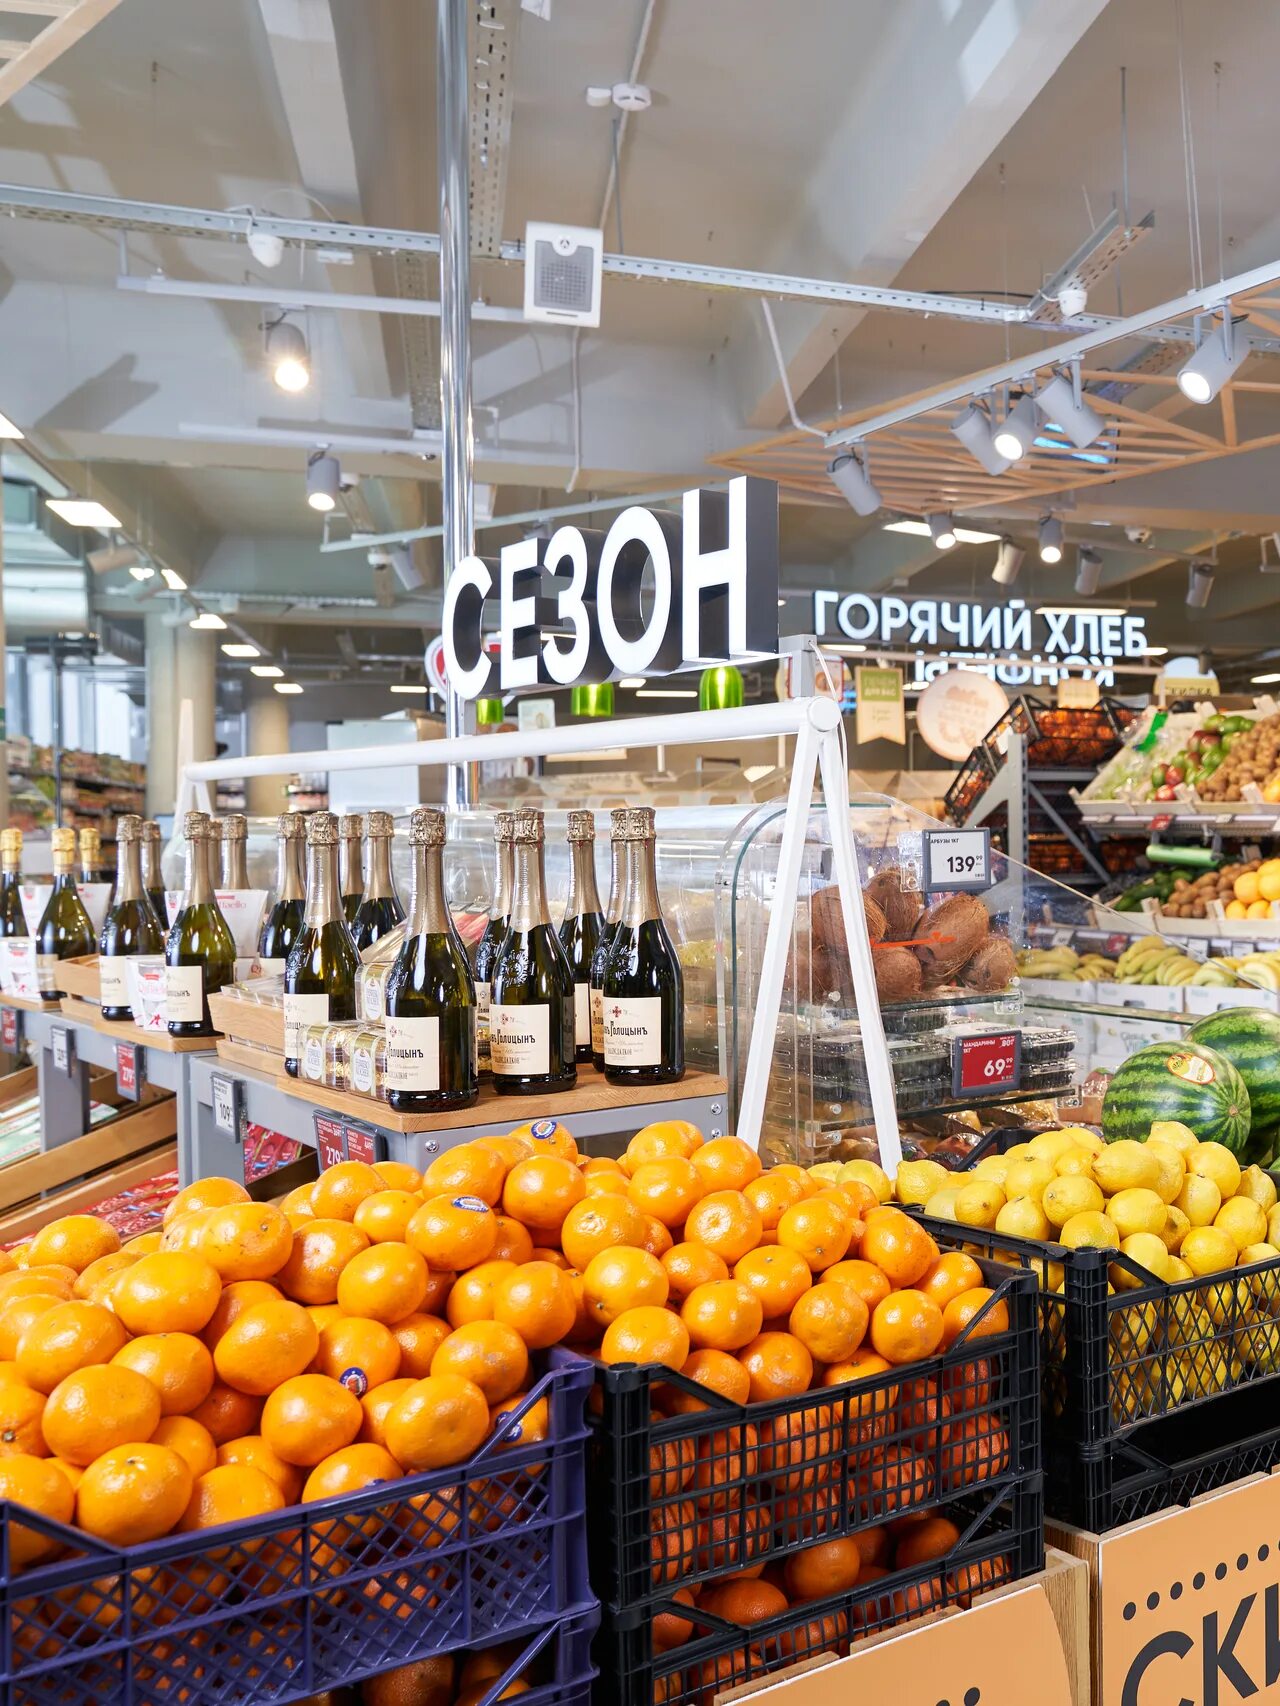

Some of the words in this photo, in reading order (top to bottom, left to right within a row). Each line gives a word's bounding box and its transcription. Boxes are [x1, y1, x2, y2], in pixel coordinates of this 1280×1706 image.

[442, 475, 752, 700] СЕЗОН
[813, 590, 1032, 652] ГОРЯЧИЙ
[1044, 614, 1149, 656] ХЛЕБ
[947, 856, 975, 873] 139
[963, 1039, 996, 1048] МАНДАРИНЫ
[984, 1058, 1006, 1077] 69
